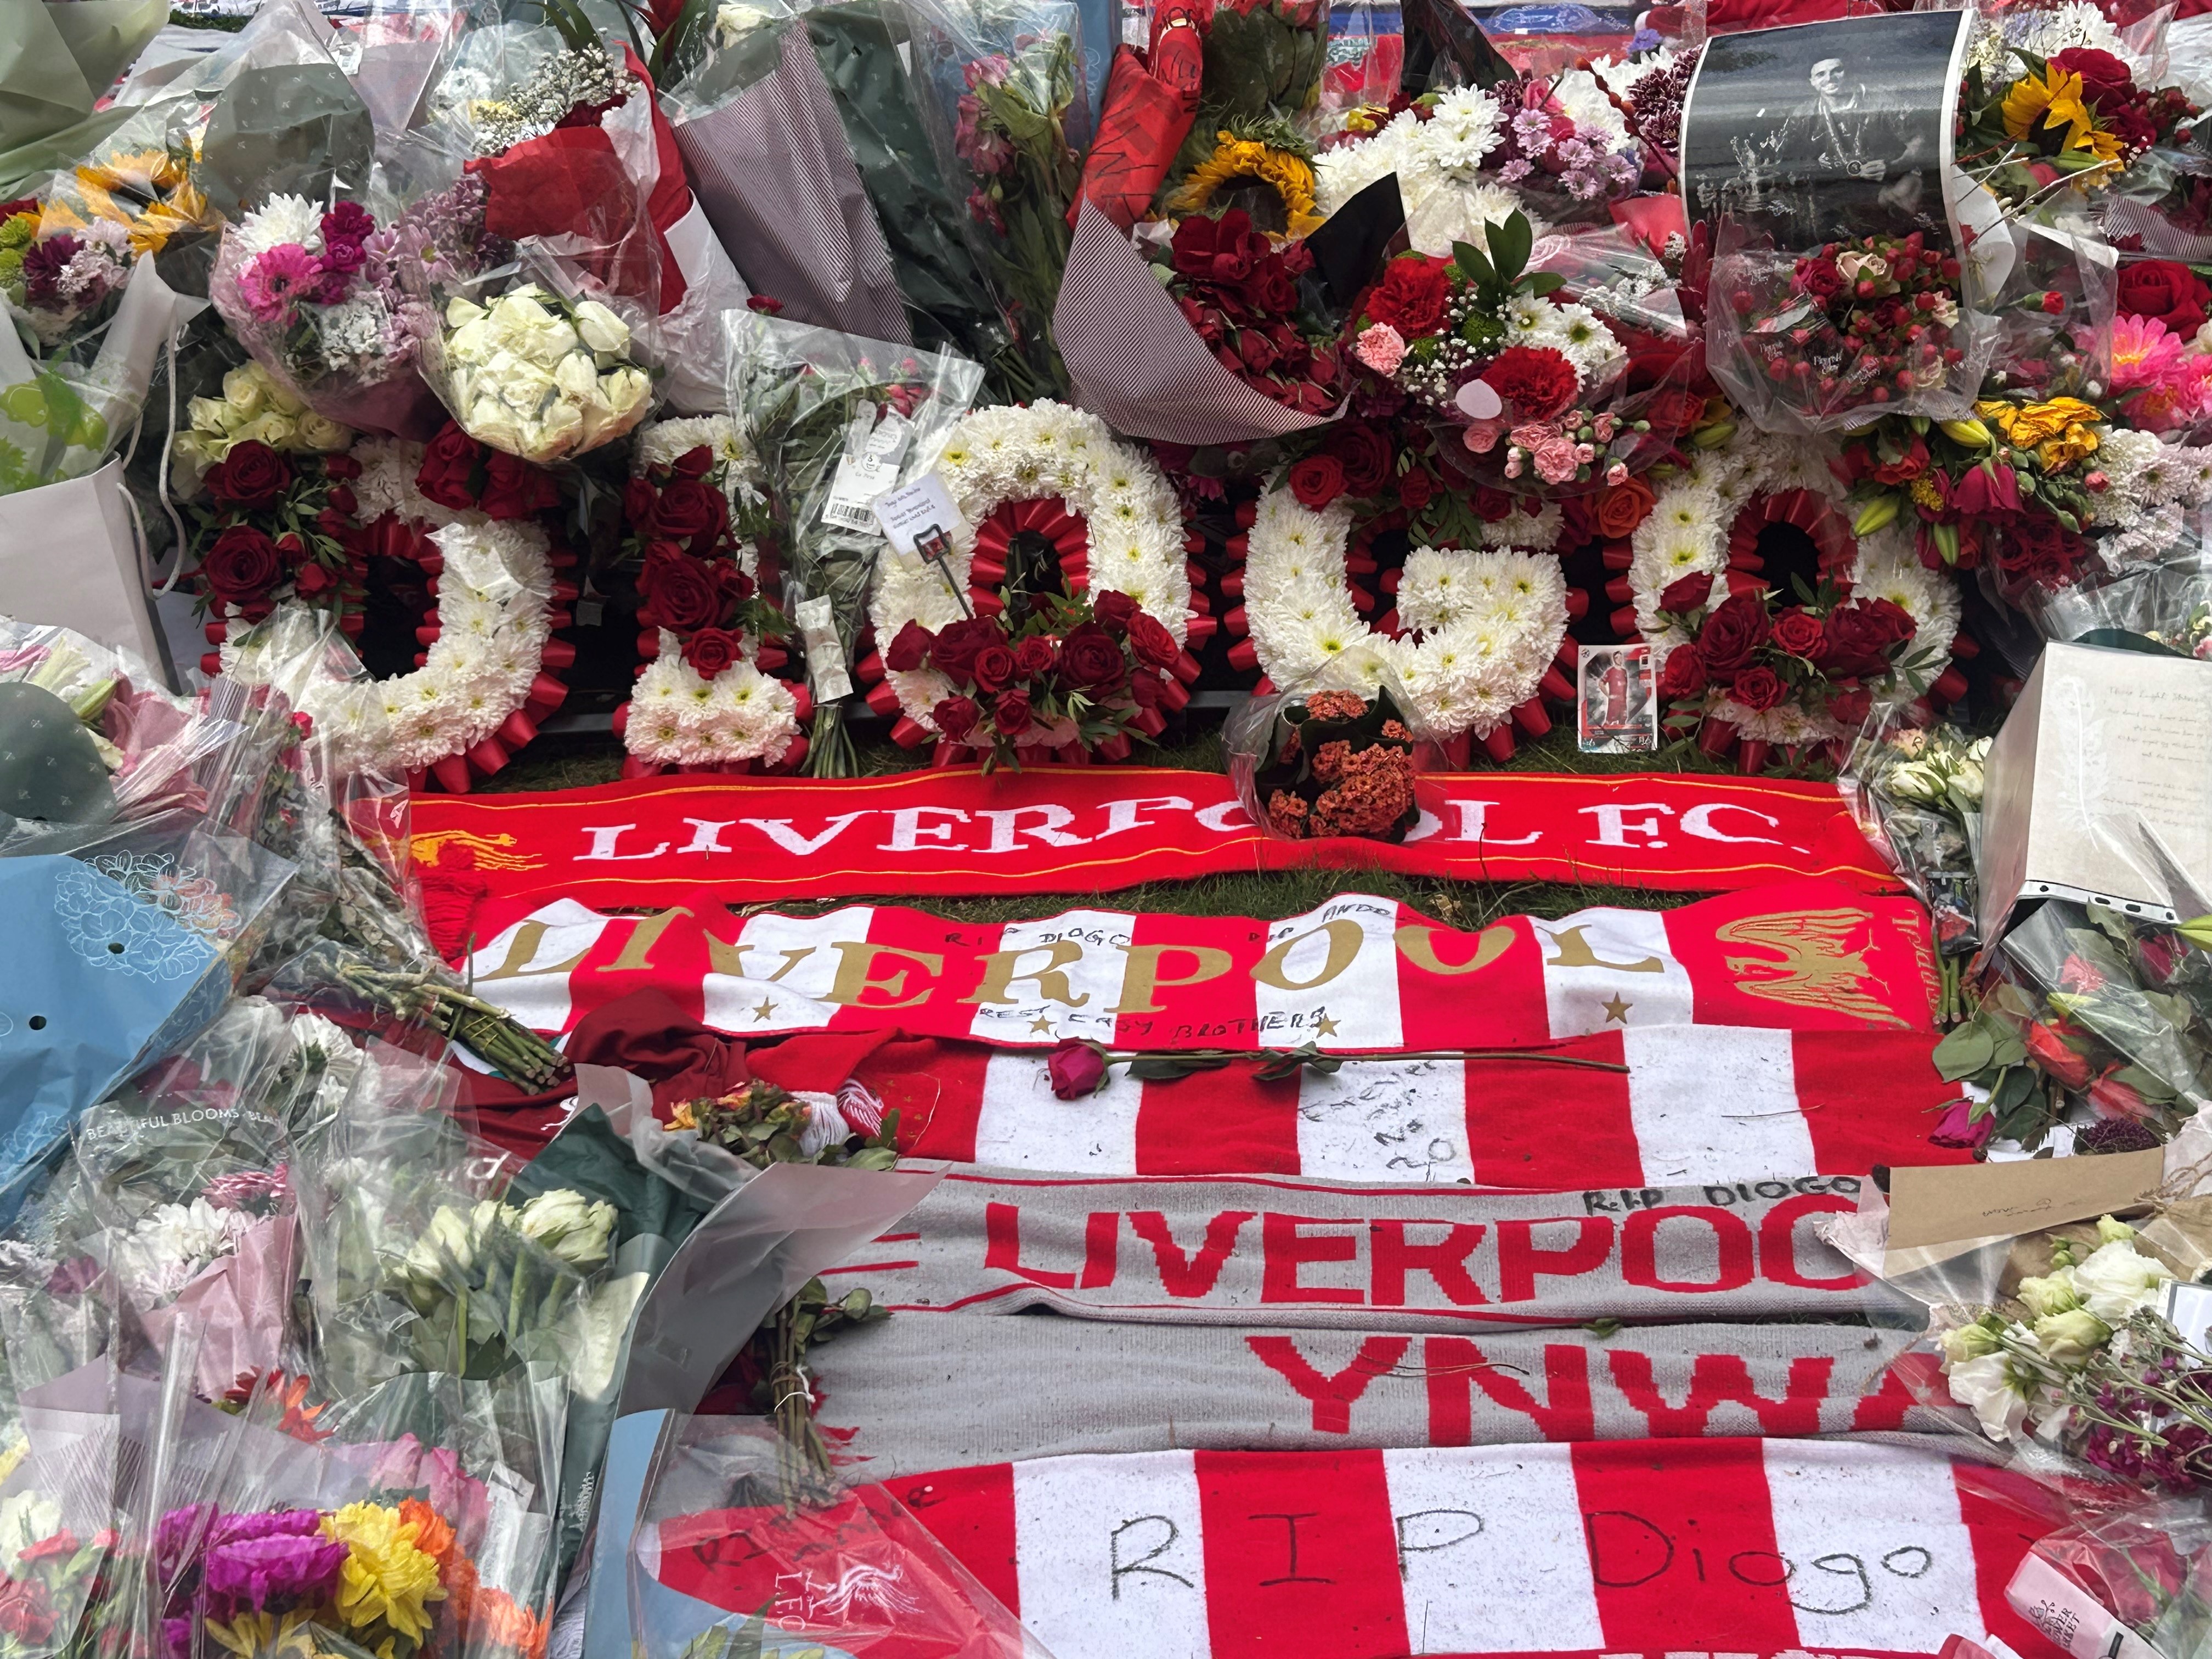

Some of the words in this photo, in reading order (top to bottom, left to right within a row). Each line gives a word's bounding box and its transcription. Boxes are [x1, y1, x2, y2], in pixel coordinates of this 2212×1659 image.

[1040, 927, 1131, 946] DIOGO
[475, 907, 1664, 1014] LIVERPOOL
[171, 1108, 239, 1125] BLOOMS
[1703, 1176, 1862, 1206] DIOGO
[1582, 1509, 1932, 1616] Diogo
